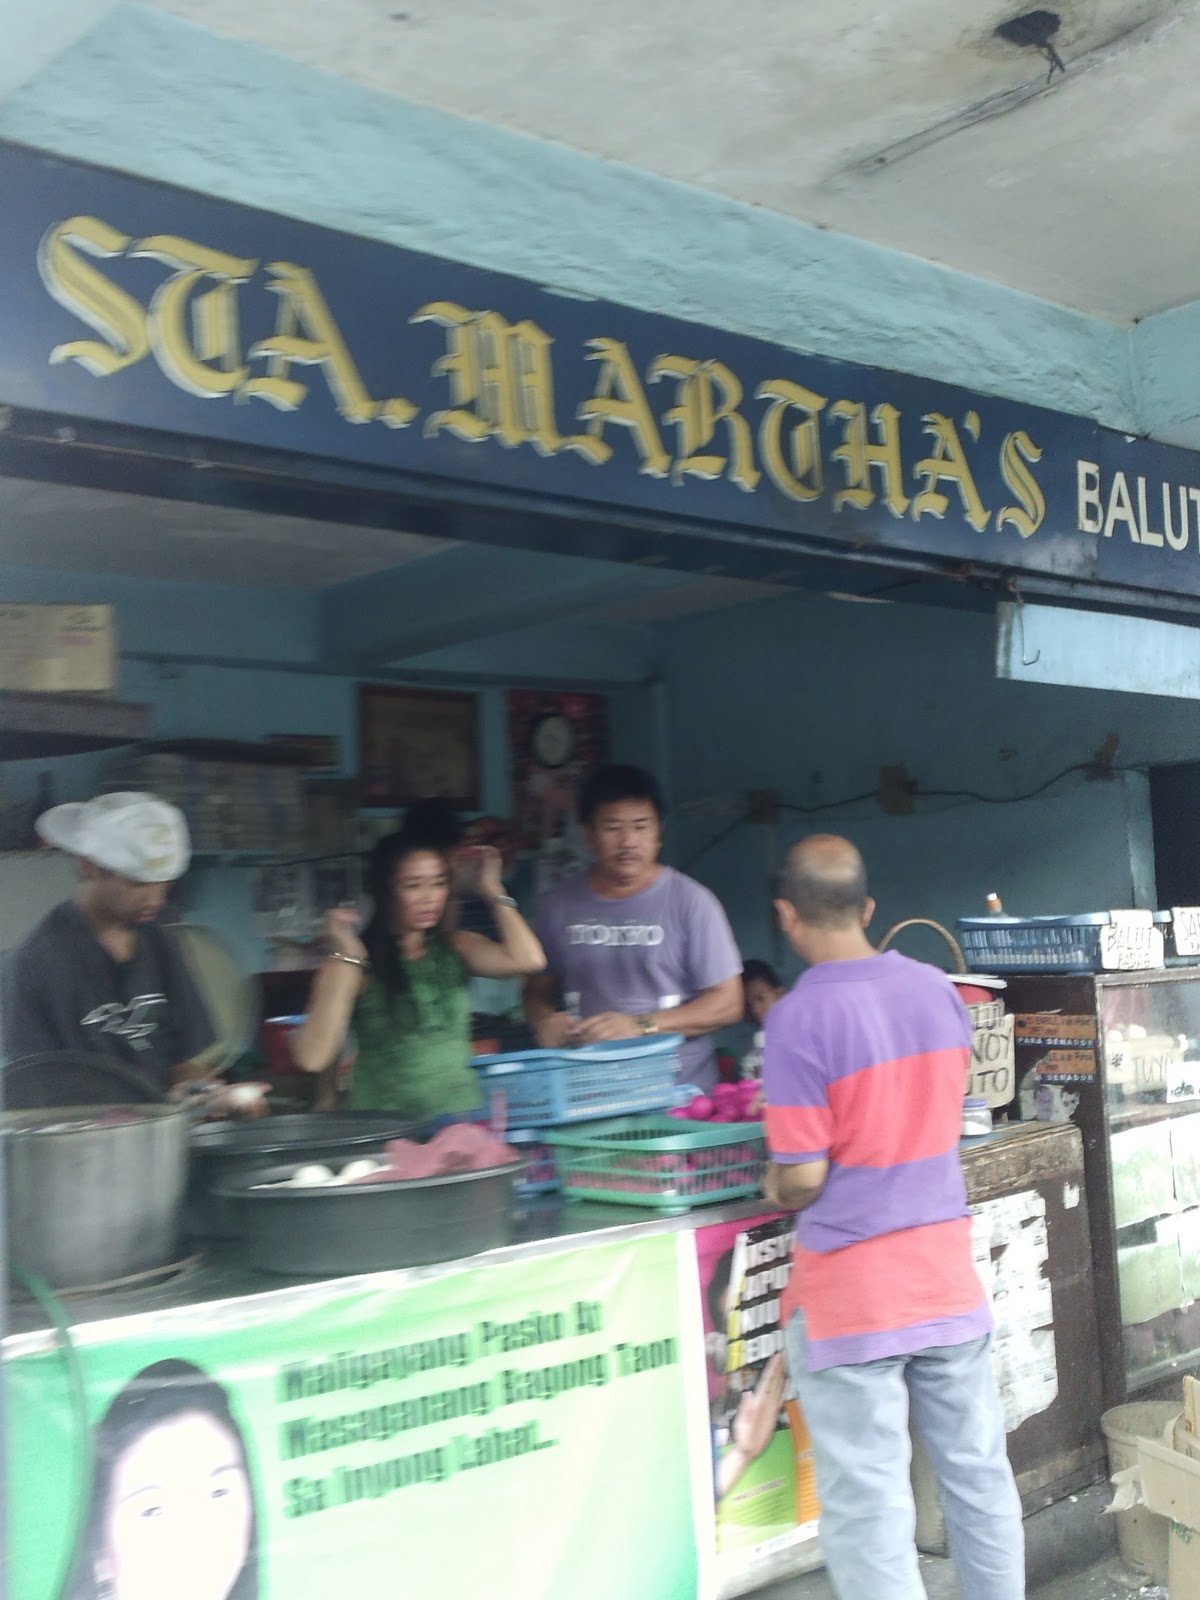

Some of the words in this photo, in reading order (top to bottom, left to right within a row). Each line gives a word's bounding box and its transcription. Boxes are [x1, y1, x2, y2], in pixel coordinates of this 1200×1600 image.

[37, 215, 418, 429] STA.
[408, 301, 1047, 539] MARTHA'S
[1107, 926, 1153, 952] BALUT
